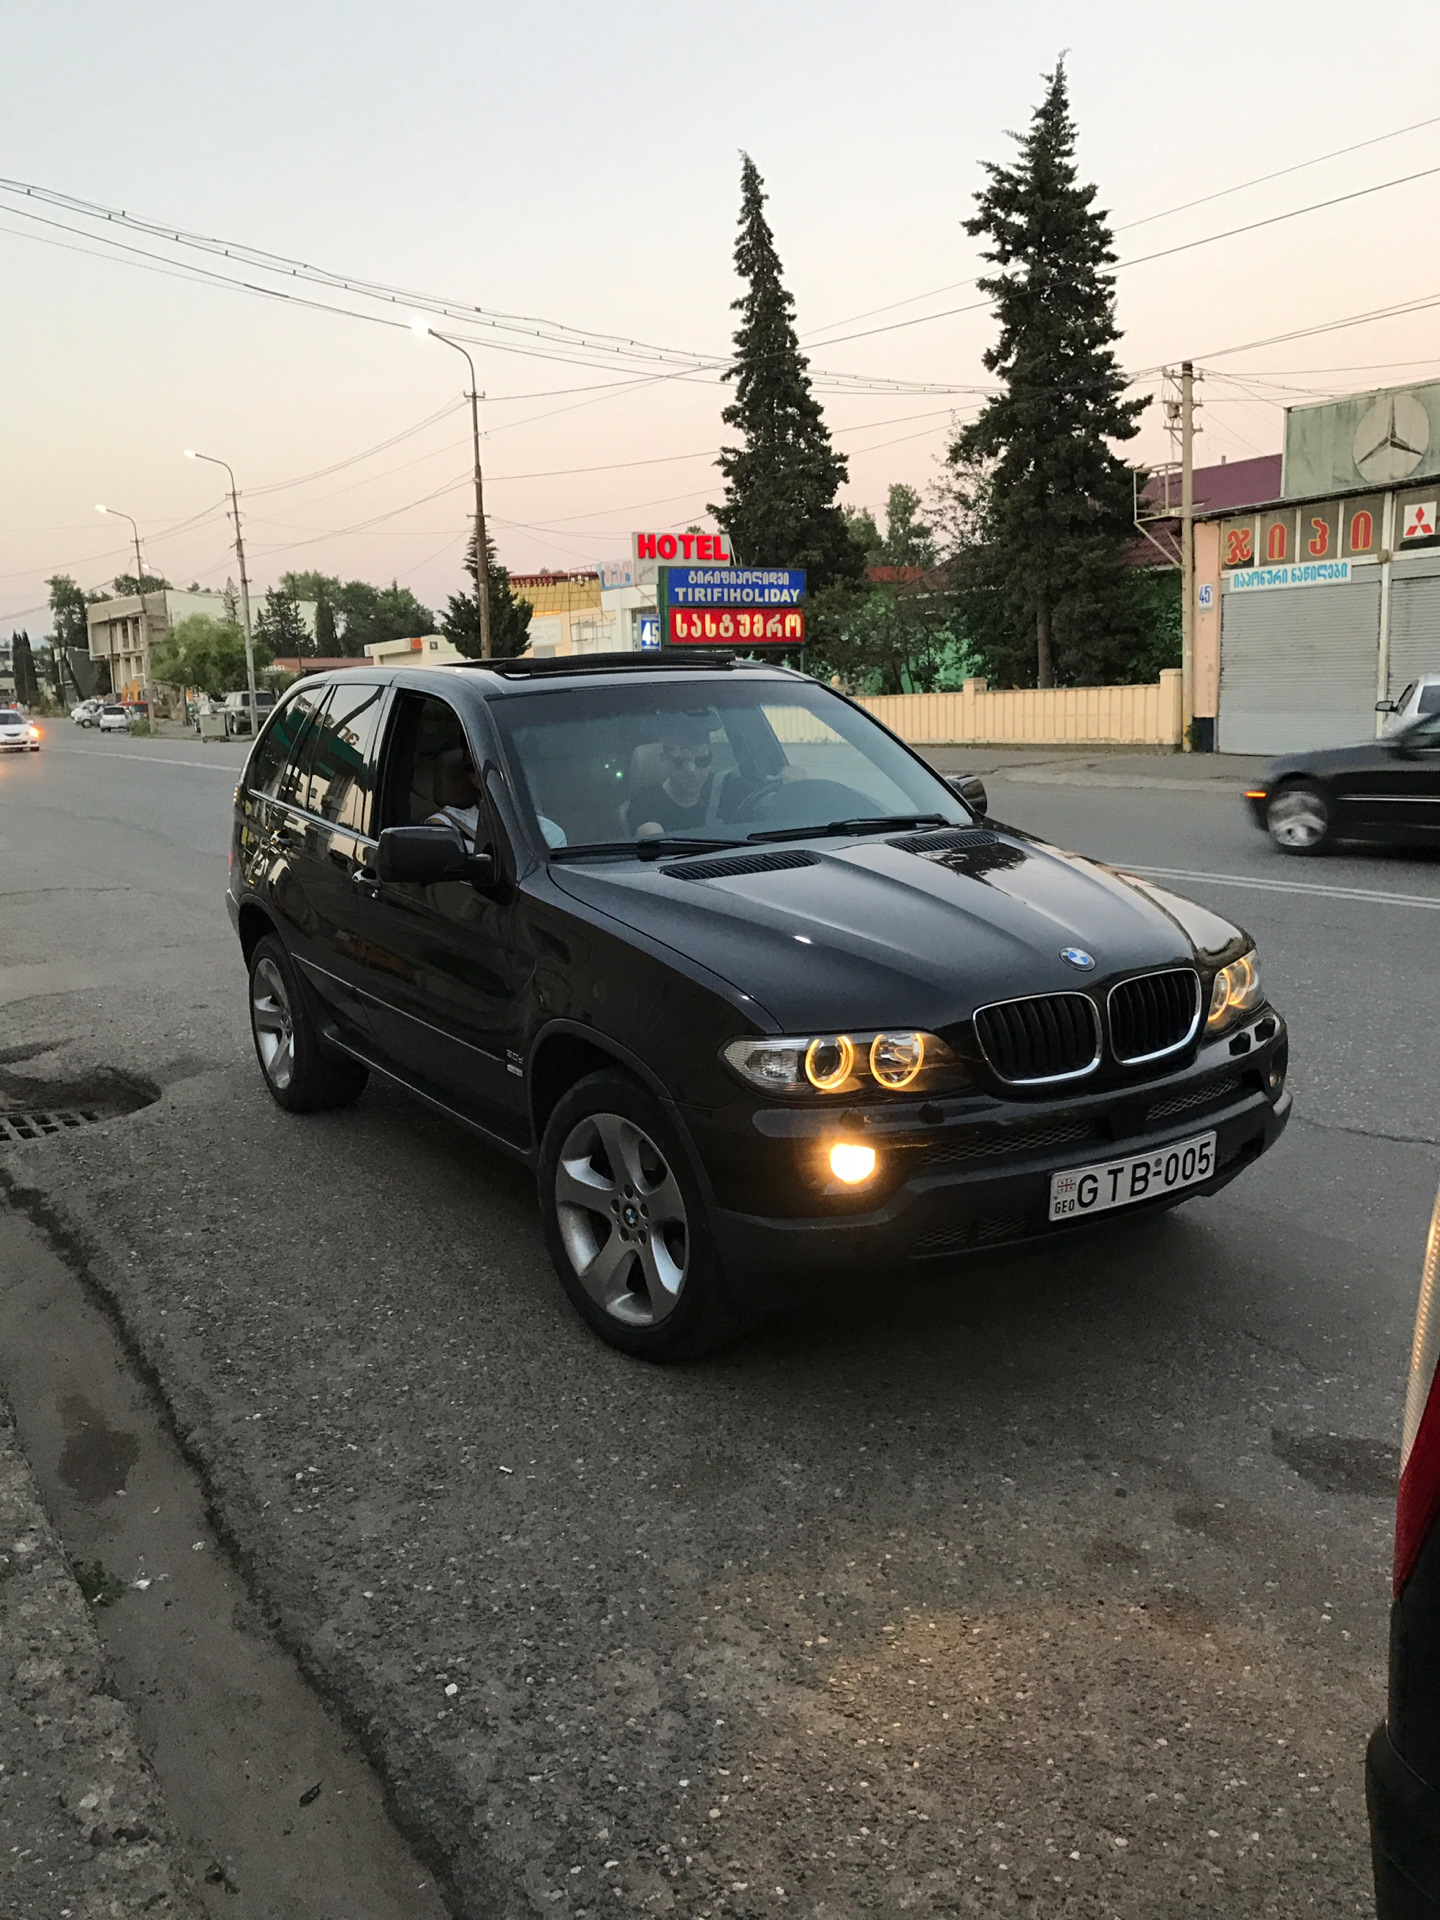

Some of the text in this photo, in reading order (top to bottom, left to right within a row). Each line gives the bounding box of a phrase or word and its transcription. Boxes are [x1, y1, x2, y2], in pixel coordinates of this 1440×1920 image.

[637, 533, 729, 561] HOTEL
[1226, 510, 1373, 565] ჯიპი
[1233, 562, 1348, 589] იაპონური ნაწილები
[675, 587, 800, 603] TIRIFIHOLIDAY
[675, 613, 802, 638] სასტუმრო
[1077, 1141, 1211, 1208] GTB-005
[1054, 1199, 1075, 1214] GEO
